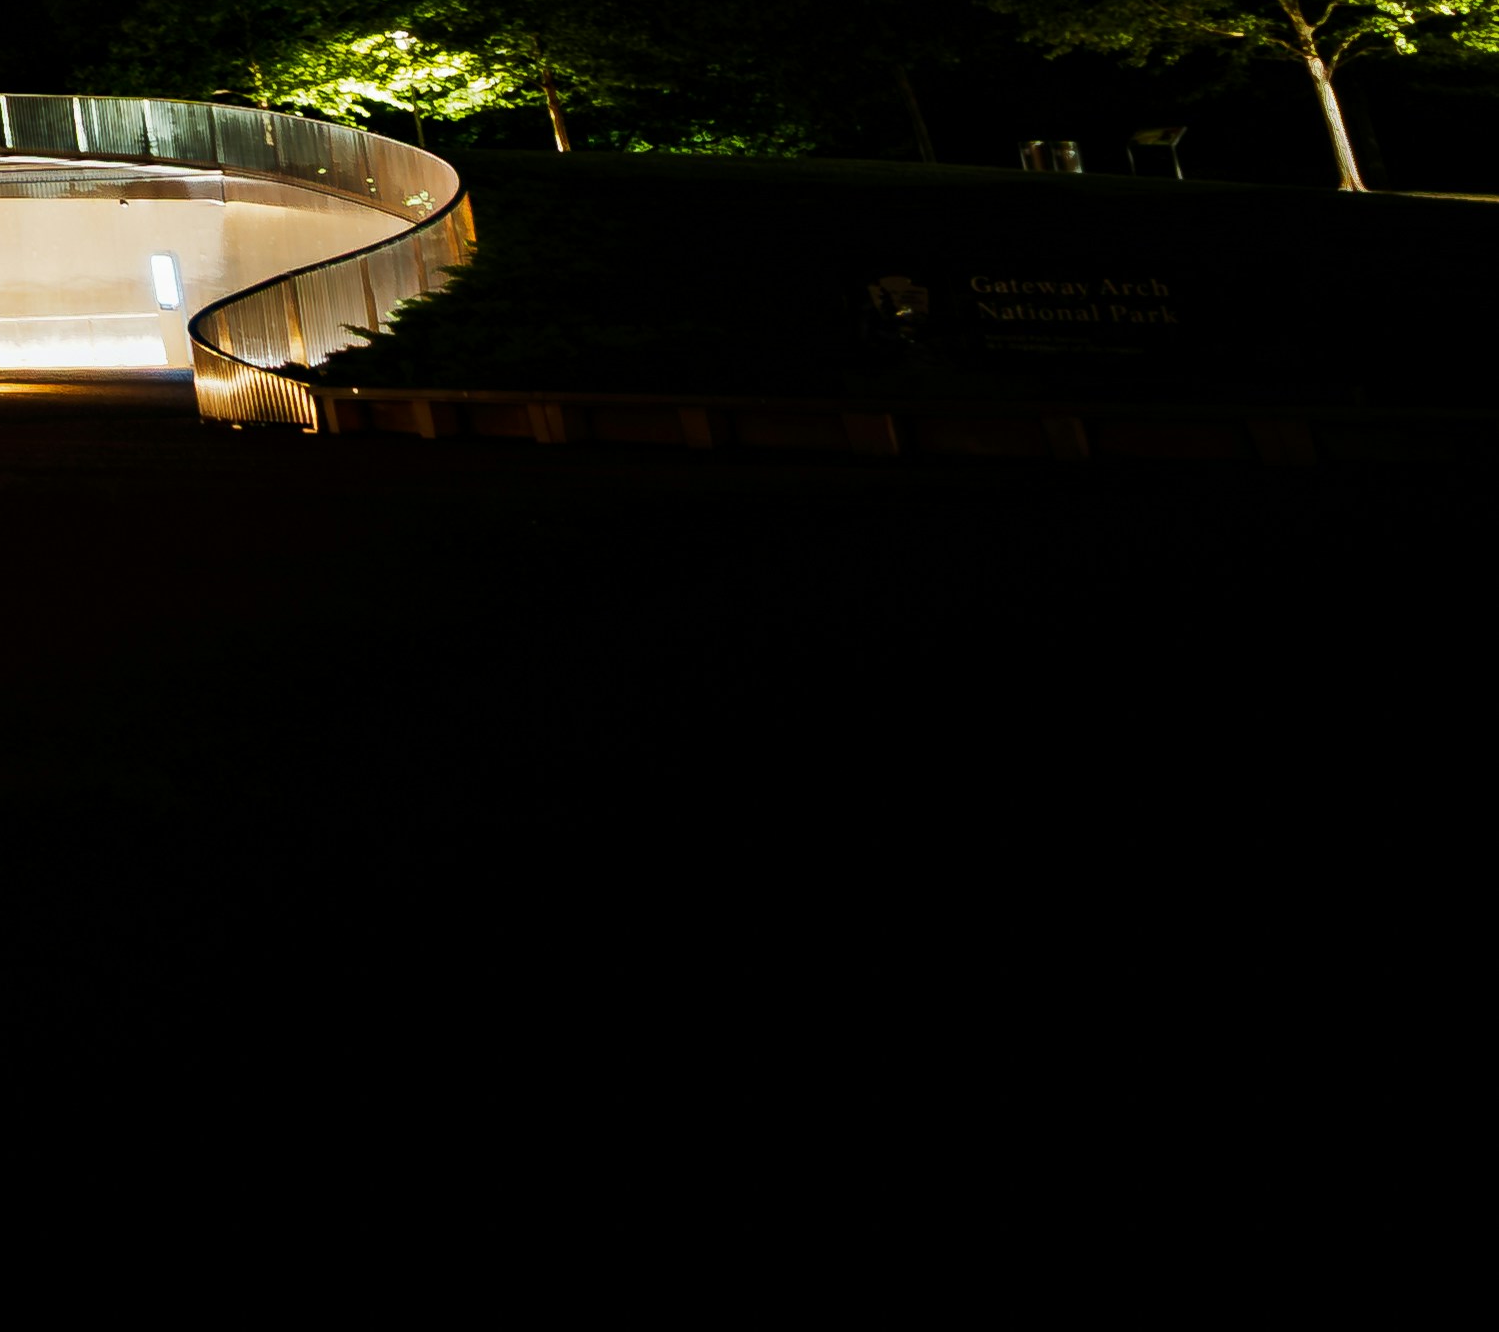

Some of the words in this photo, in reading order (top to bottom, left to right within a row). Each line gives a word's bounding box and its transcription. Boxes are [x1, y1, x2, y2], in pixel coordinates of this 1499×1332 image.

[970, 275, 1089, 300] Gateway
[1101, 278, 1170, 296] Arch
[977, 301, 1102, 322] National
[1109, 304, 1180, 324] Park
